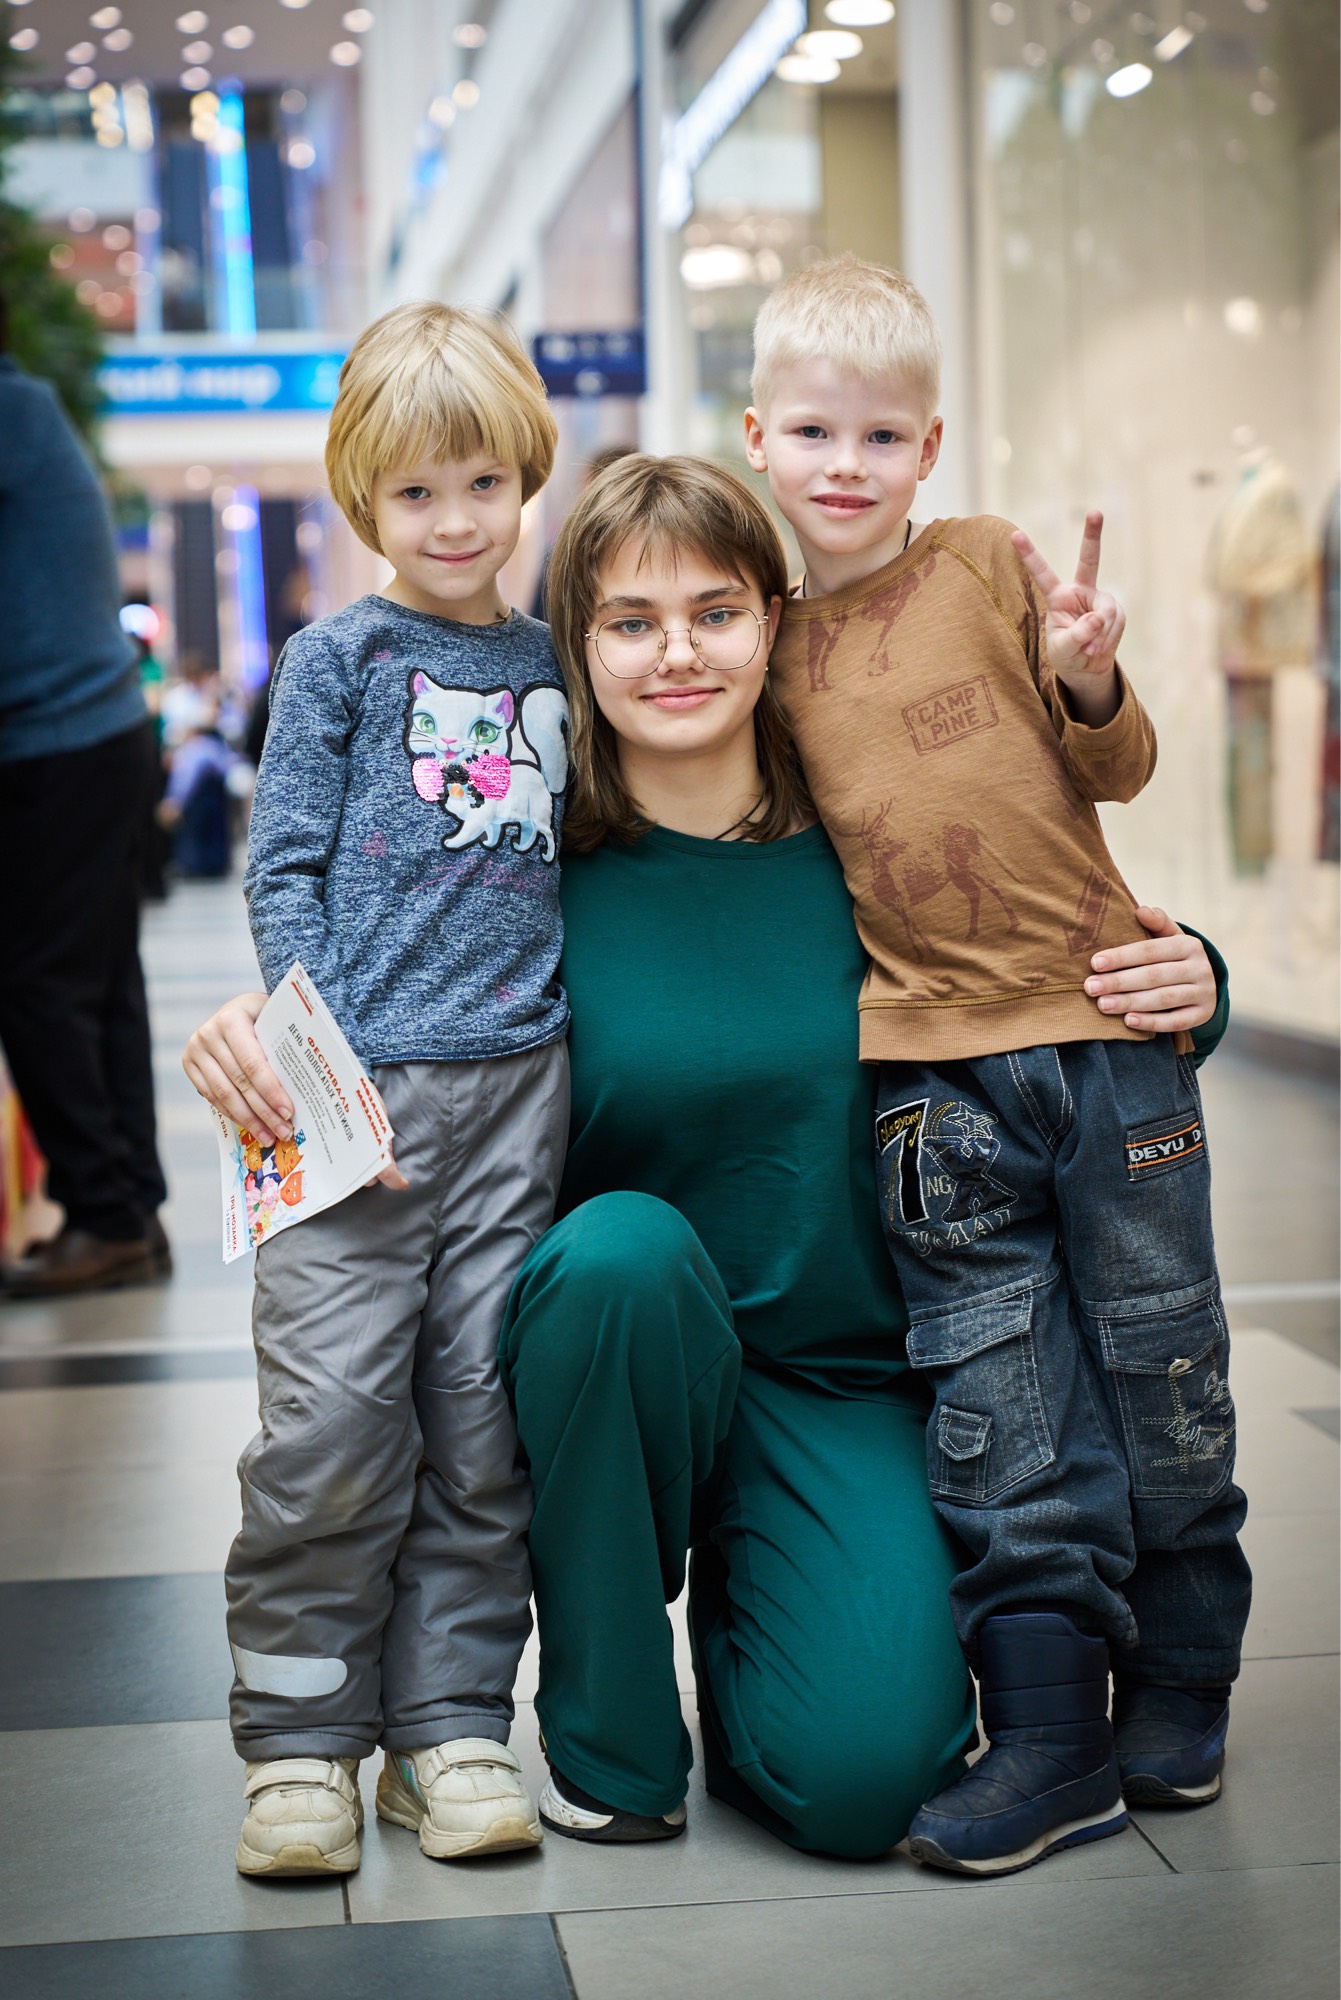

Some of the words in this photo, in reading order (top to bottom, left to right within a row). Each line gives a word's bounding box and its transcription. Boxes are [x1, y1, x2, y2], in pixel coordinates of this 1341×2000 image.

[918, 687, 976, 724] CAMP
[930, 707, 980, 741] PINE
[287, 1023, 303, 1047] ДЕНЬ
[303, 1048, 336, 1099] ПОЛОСАТЫХ
[332, 1101, 353, 1141] КОТИКОВ
[307, 1036, 349, 1112] ФЕСТИВАЛЬ
[355, 1089, 381, 1146] МОЗАИКА
[1129, 1138, 1185, 1162] DEYU
